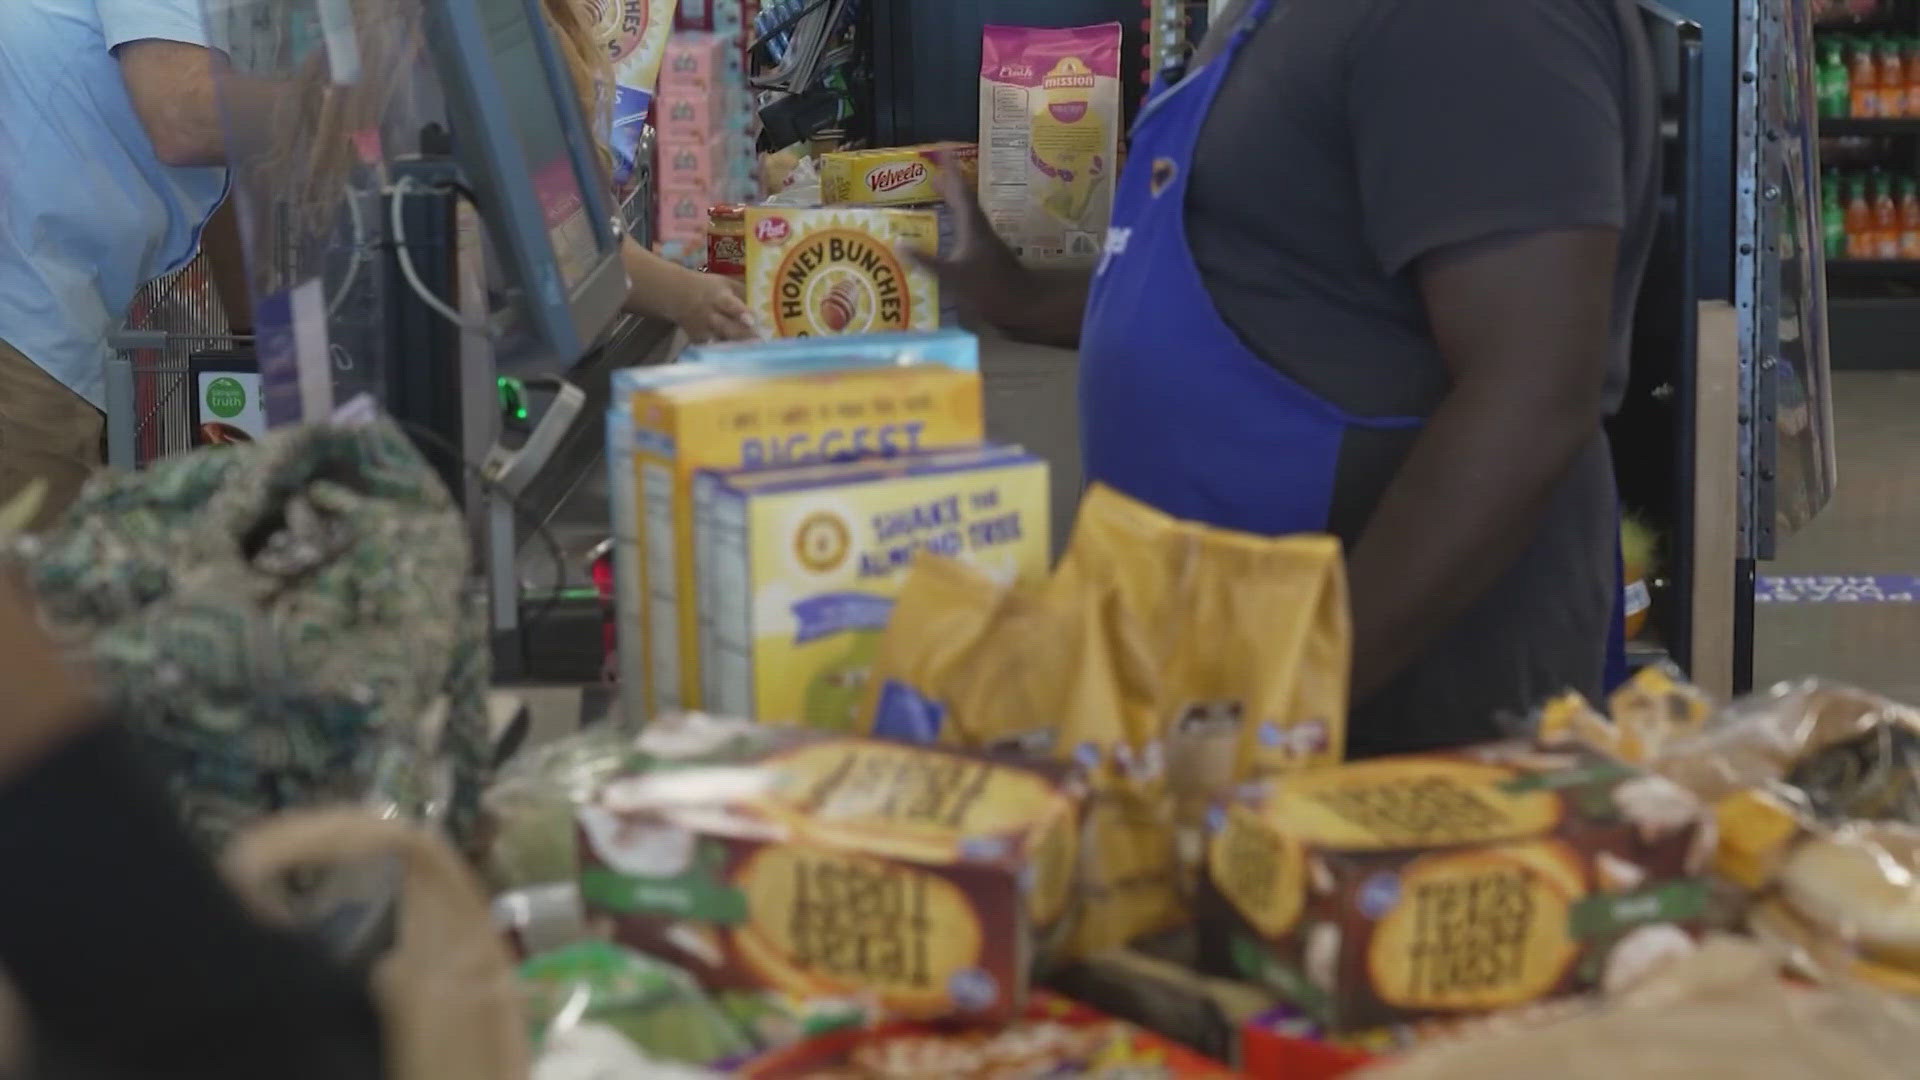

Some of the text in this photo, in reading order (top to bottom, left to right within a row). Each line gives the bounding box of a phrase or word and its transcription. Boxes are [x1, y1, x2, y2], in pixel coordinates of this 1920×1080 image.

[1045, 76, 1094, 88] mission
[871, 162, 924, 192] Velveeta
[758, 218, 787, 240] Post
[782, 238, 901, 323] HONEY BUNCHES
[212, 396, 242, 407] truth
